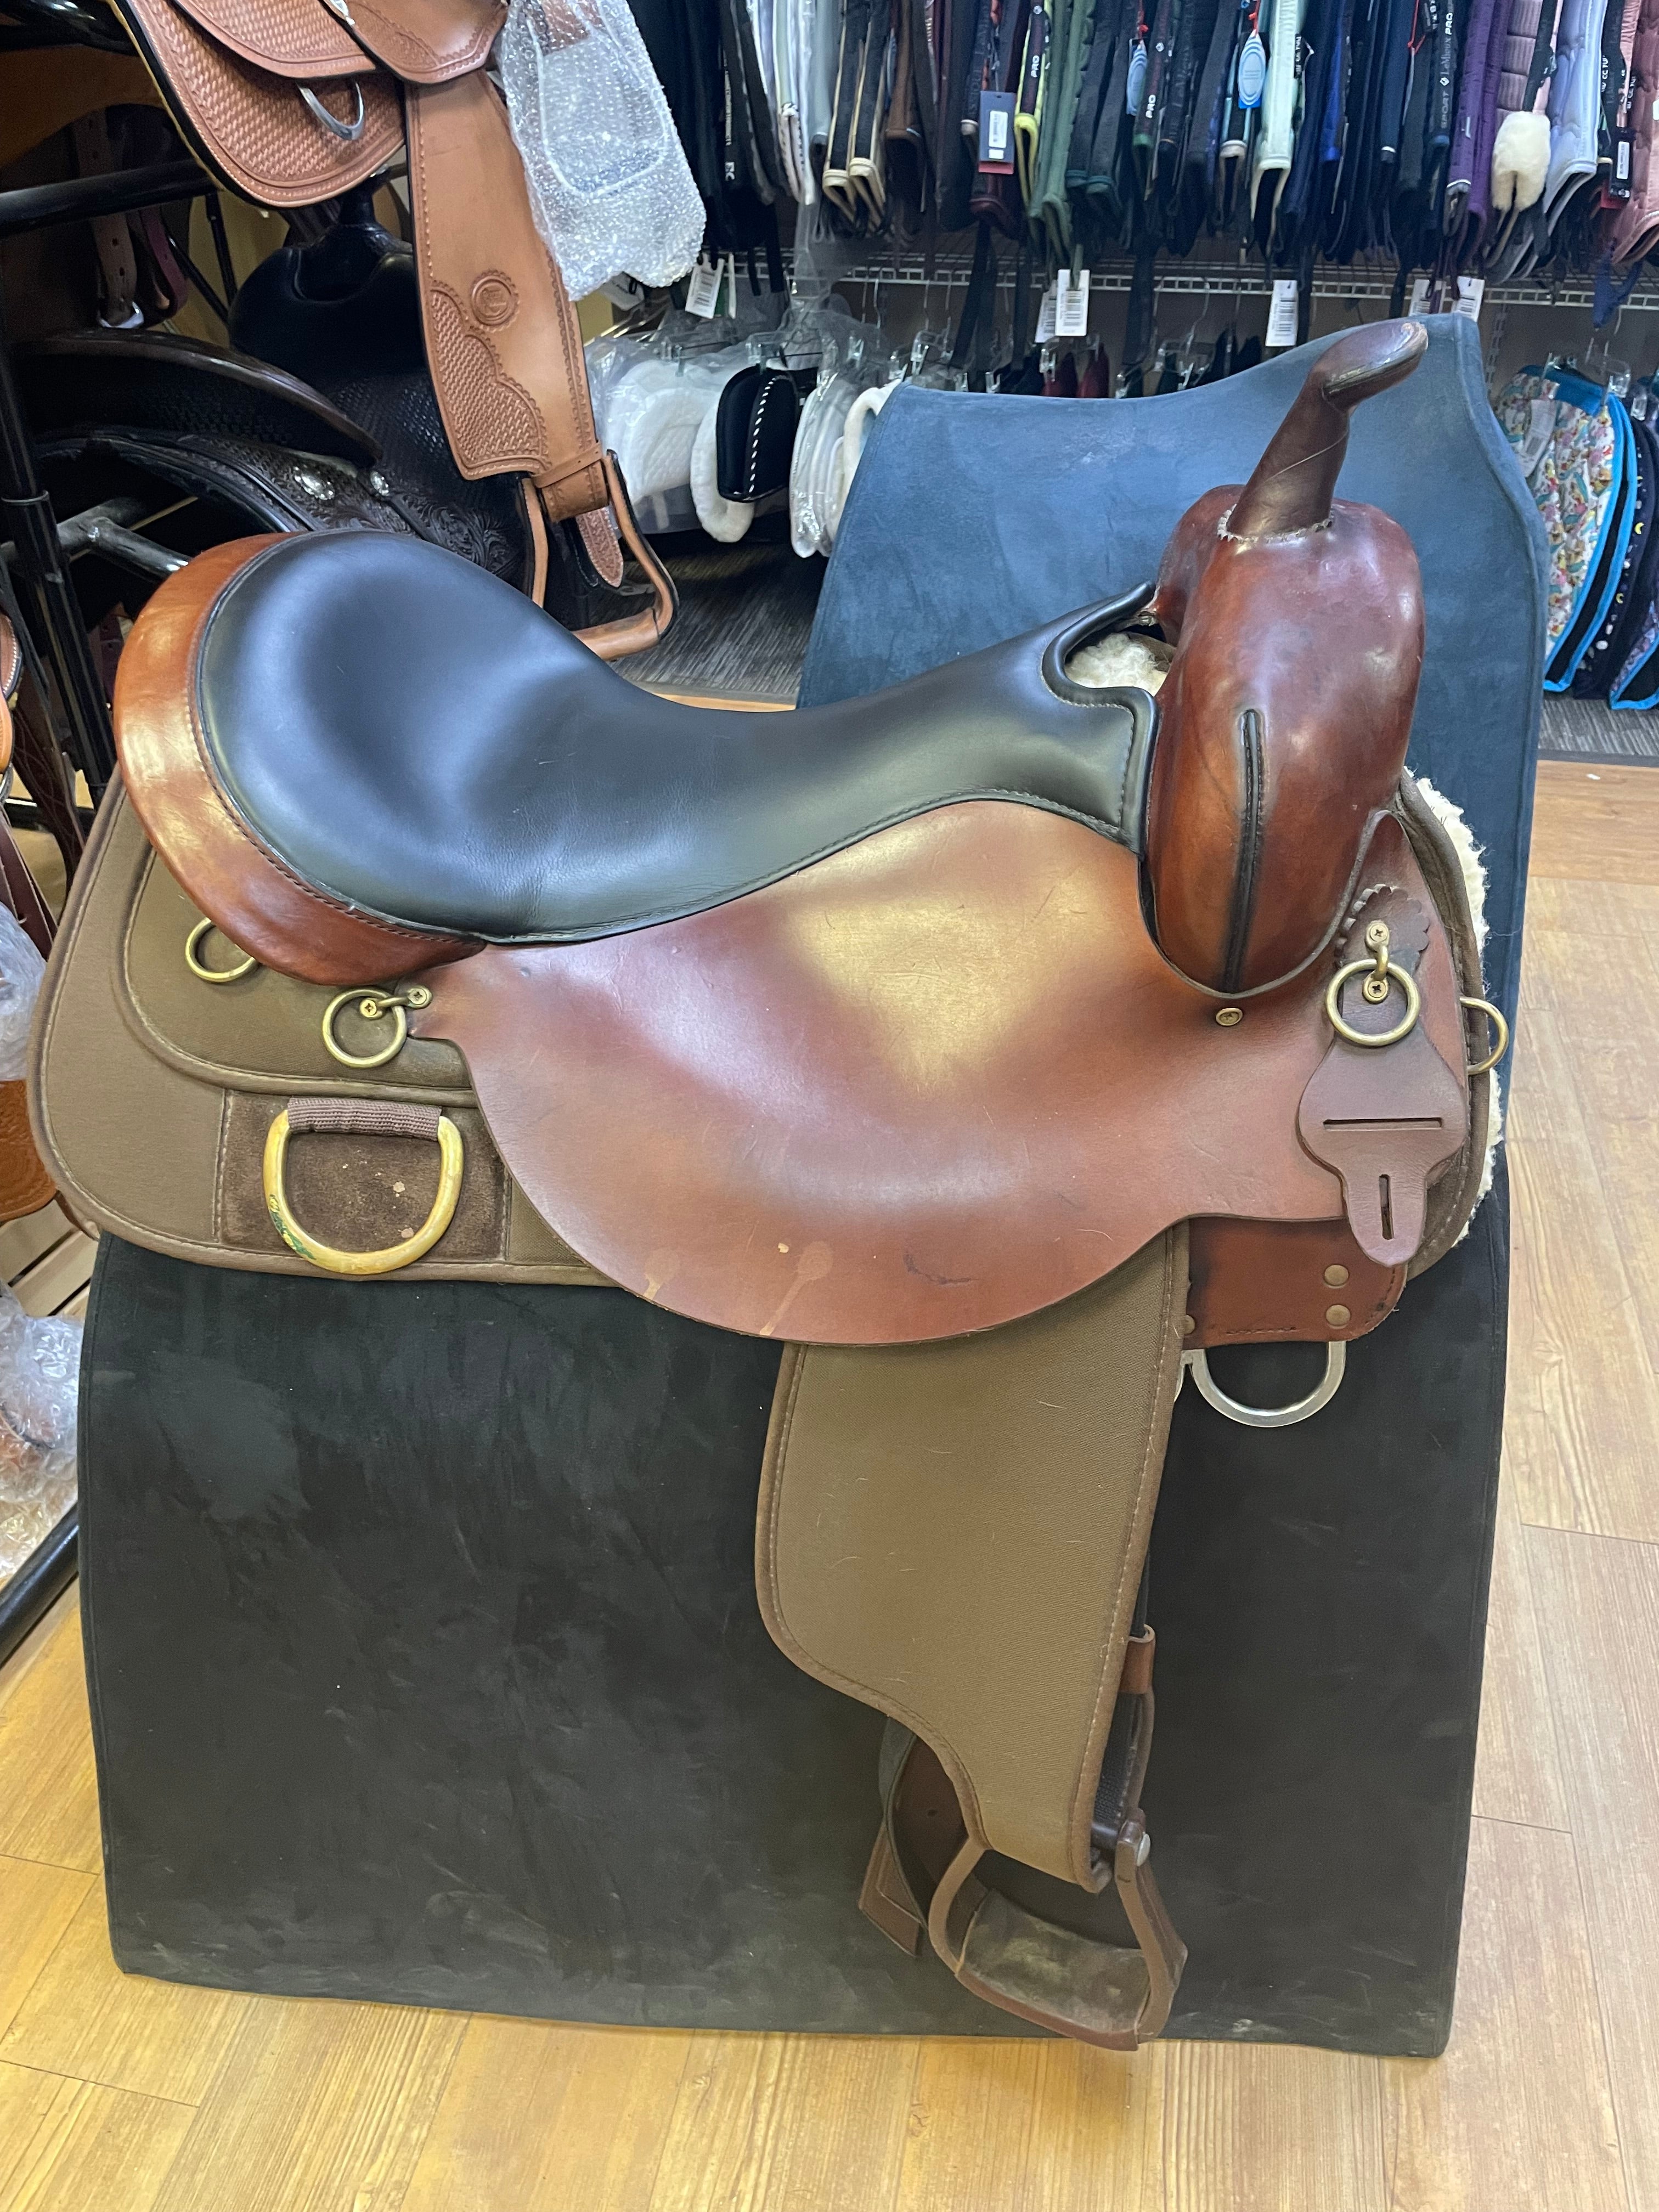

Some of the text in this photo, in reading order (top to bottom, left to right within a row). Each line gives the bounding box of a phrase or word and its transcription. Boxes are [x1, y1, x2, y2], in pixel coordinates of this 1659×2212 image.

[1031, 55, 1040, 77] PRO
[1440, 37, 1451, 75] LeMieux
[1146, 94, 1156, 119] PRO
[1441, 91, 1449, 128] SPORT
